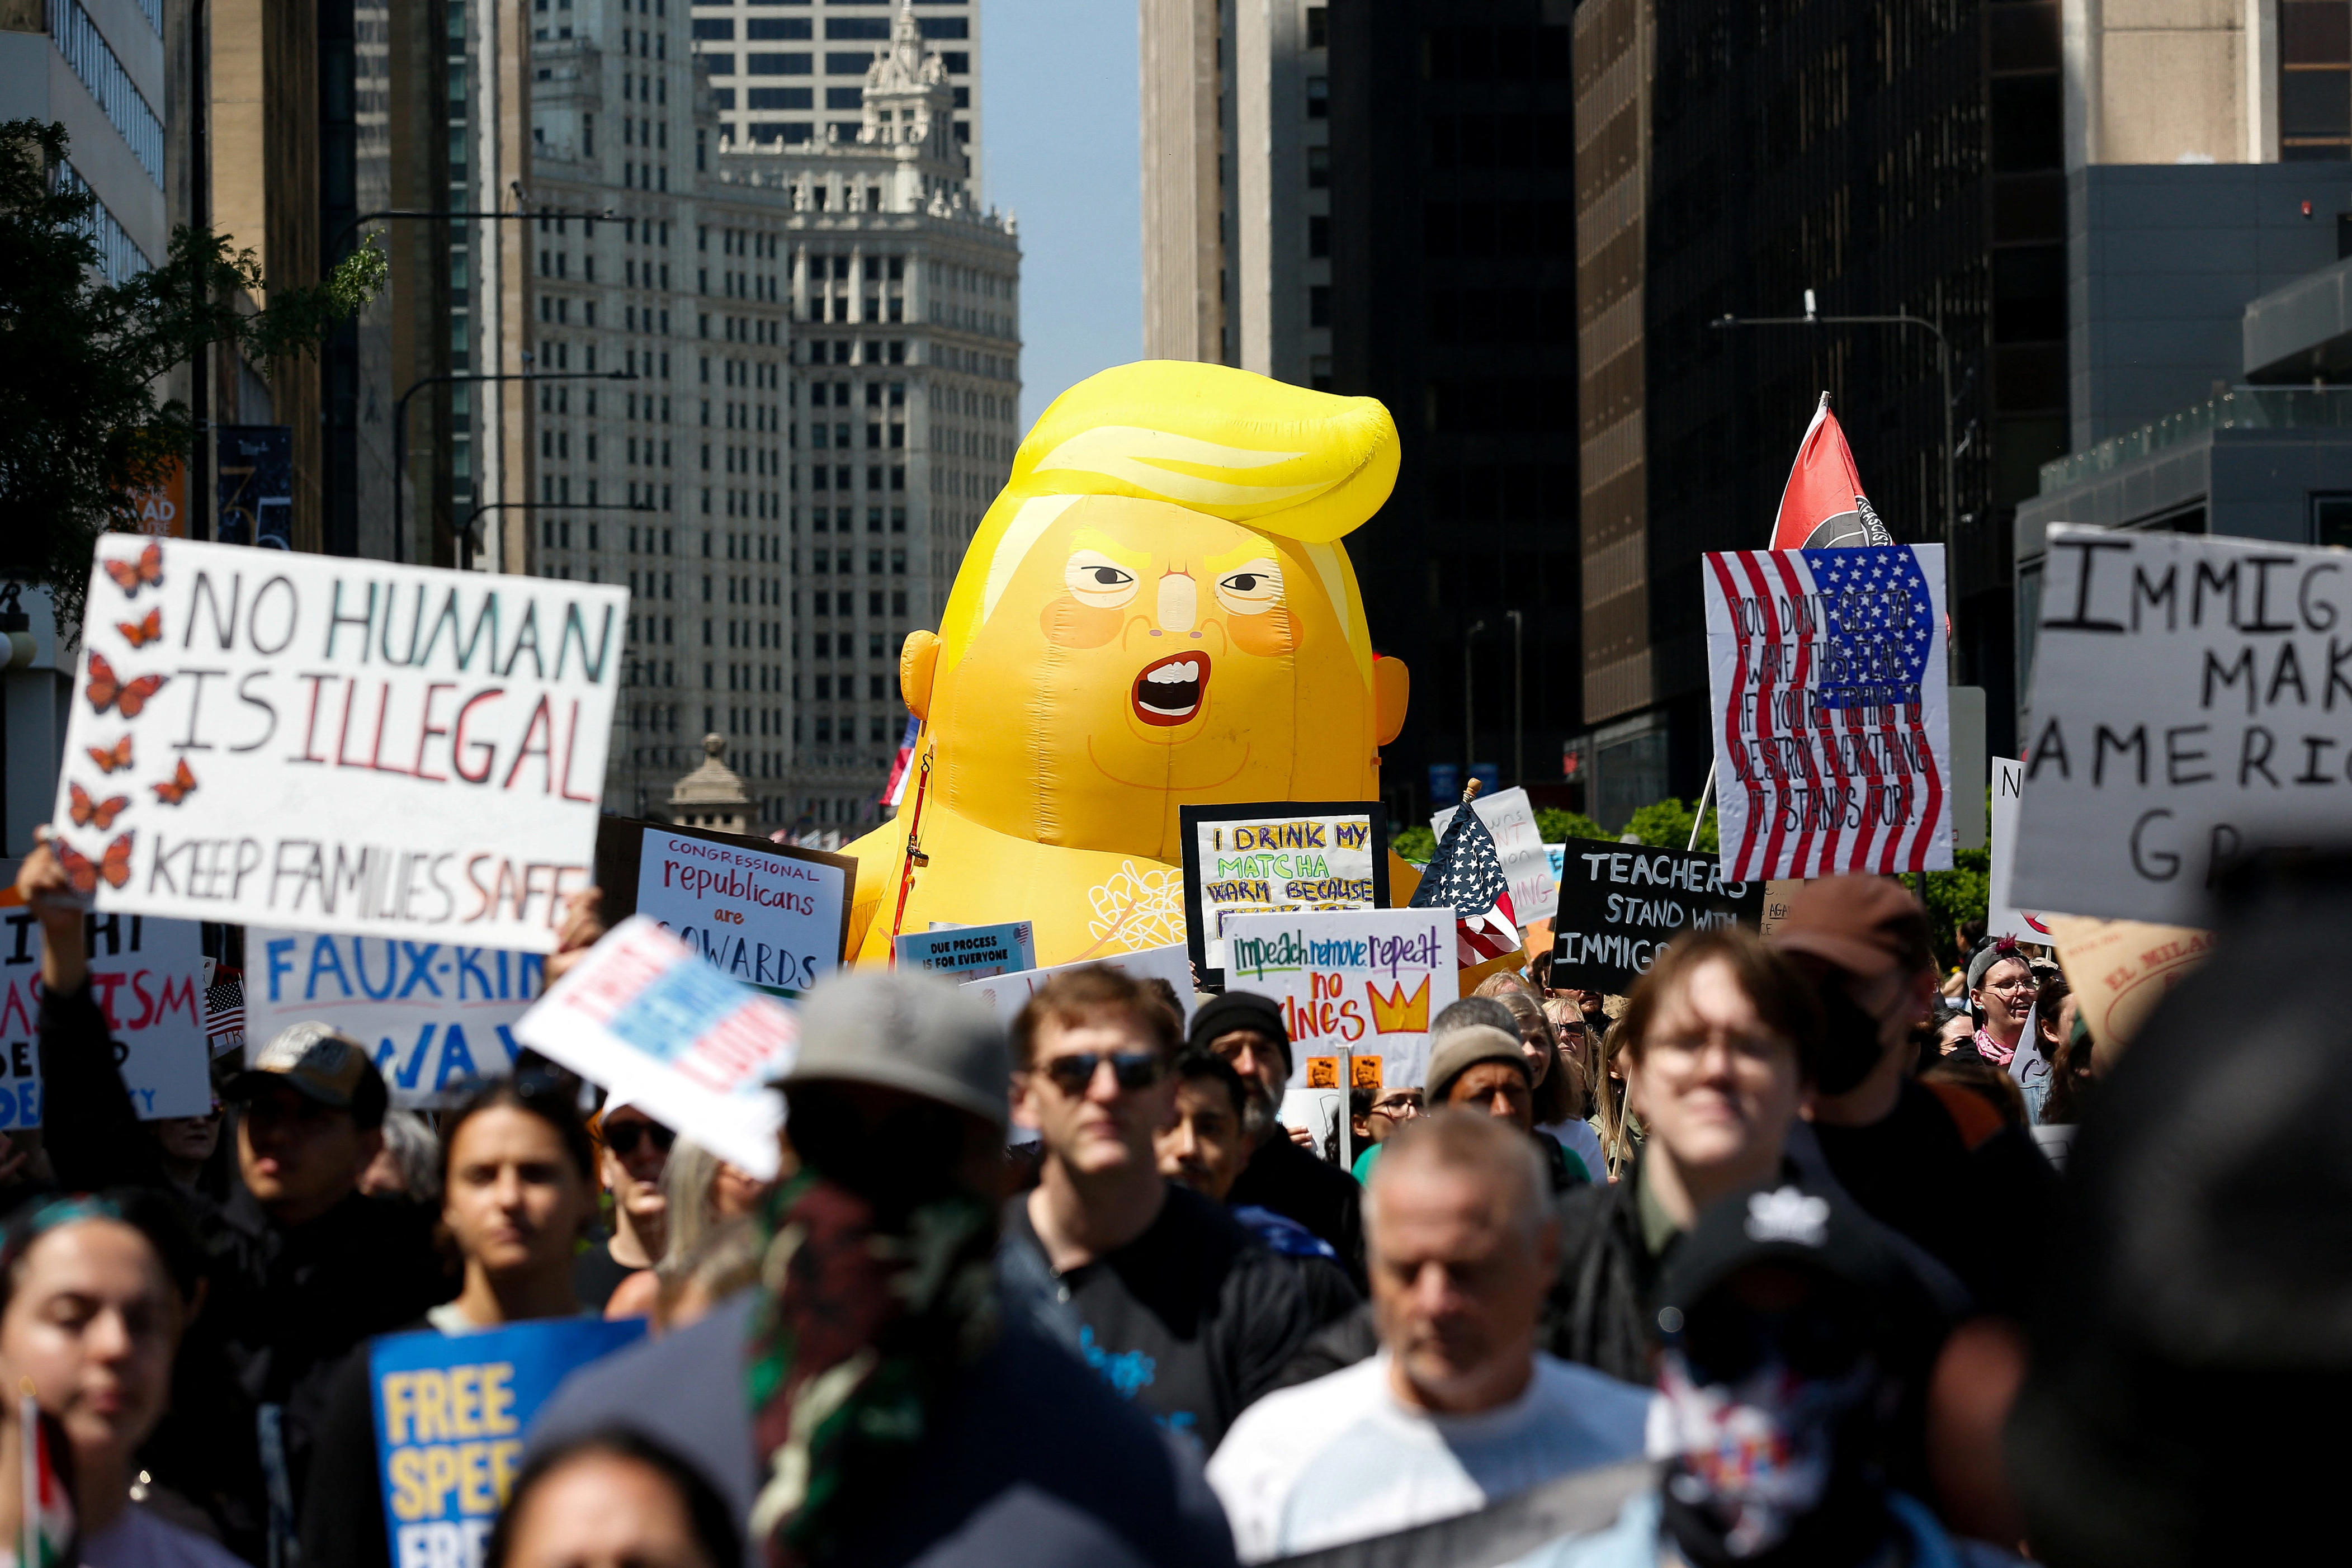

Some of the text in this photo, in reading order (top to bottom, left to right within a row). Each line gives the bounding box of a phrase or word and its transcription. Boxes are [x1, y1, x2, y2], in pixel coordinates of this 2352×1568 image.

[2043, 540, 2343, 632] IMMIG
[183, 571, 615, 683] NO HUMAN
[1731, 595, 1768, 639] YOU
[1839, 589, 1877, 635] GET
[1883, 589, 1910, 632] TO
[1742, 637, 1905, 685] WAVE THIS FLAG
[2201, 637, 2352, 715] MAK
[1739, 692, 1759, 733] IF
[1836, 686, 1897, 728] TRYING
[1902, 683, 1922, 724] TO
[171, 668, 598, 804] IS ILLEGAL
[1734, 730, 1929, 782] DESTROY EVERYTHING
[1750, 789, 1772, 834] IT
[1780, 785, 1862, 833] STANDS
[668, 839, 821, 882] CONGRESSIONAL
[1214, 822, 1369, 851] I DRINK MY
[149, 834, 263, 900] KEEP
[269, 839, 459, 925] FAMILIES
[663, 859, 815, 916] republicans
[1207, 878, 1373, 903] WARM BECAUSE
[1217, 854, 1330, 879] MATCHA
[714, 908, 745, 925] are
[1604, 892, 1737, 932] STAND WITH
[265, 932, 546, 1002] FAUX-KIN
[657, 921, 818, 990] OWARDS
[923, 948, 1008, 970] IS FOR EVERYONE
[930, 936, 997, 954] DUE PROCESS
[1309, 971, 1343, 1000] no
[382, 1361, 519, 1446] FREE
